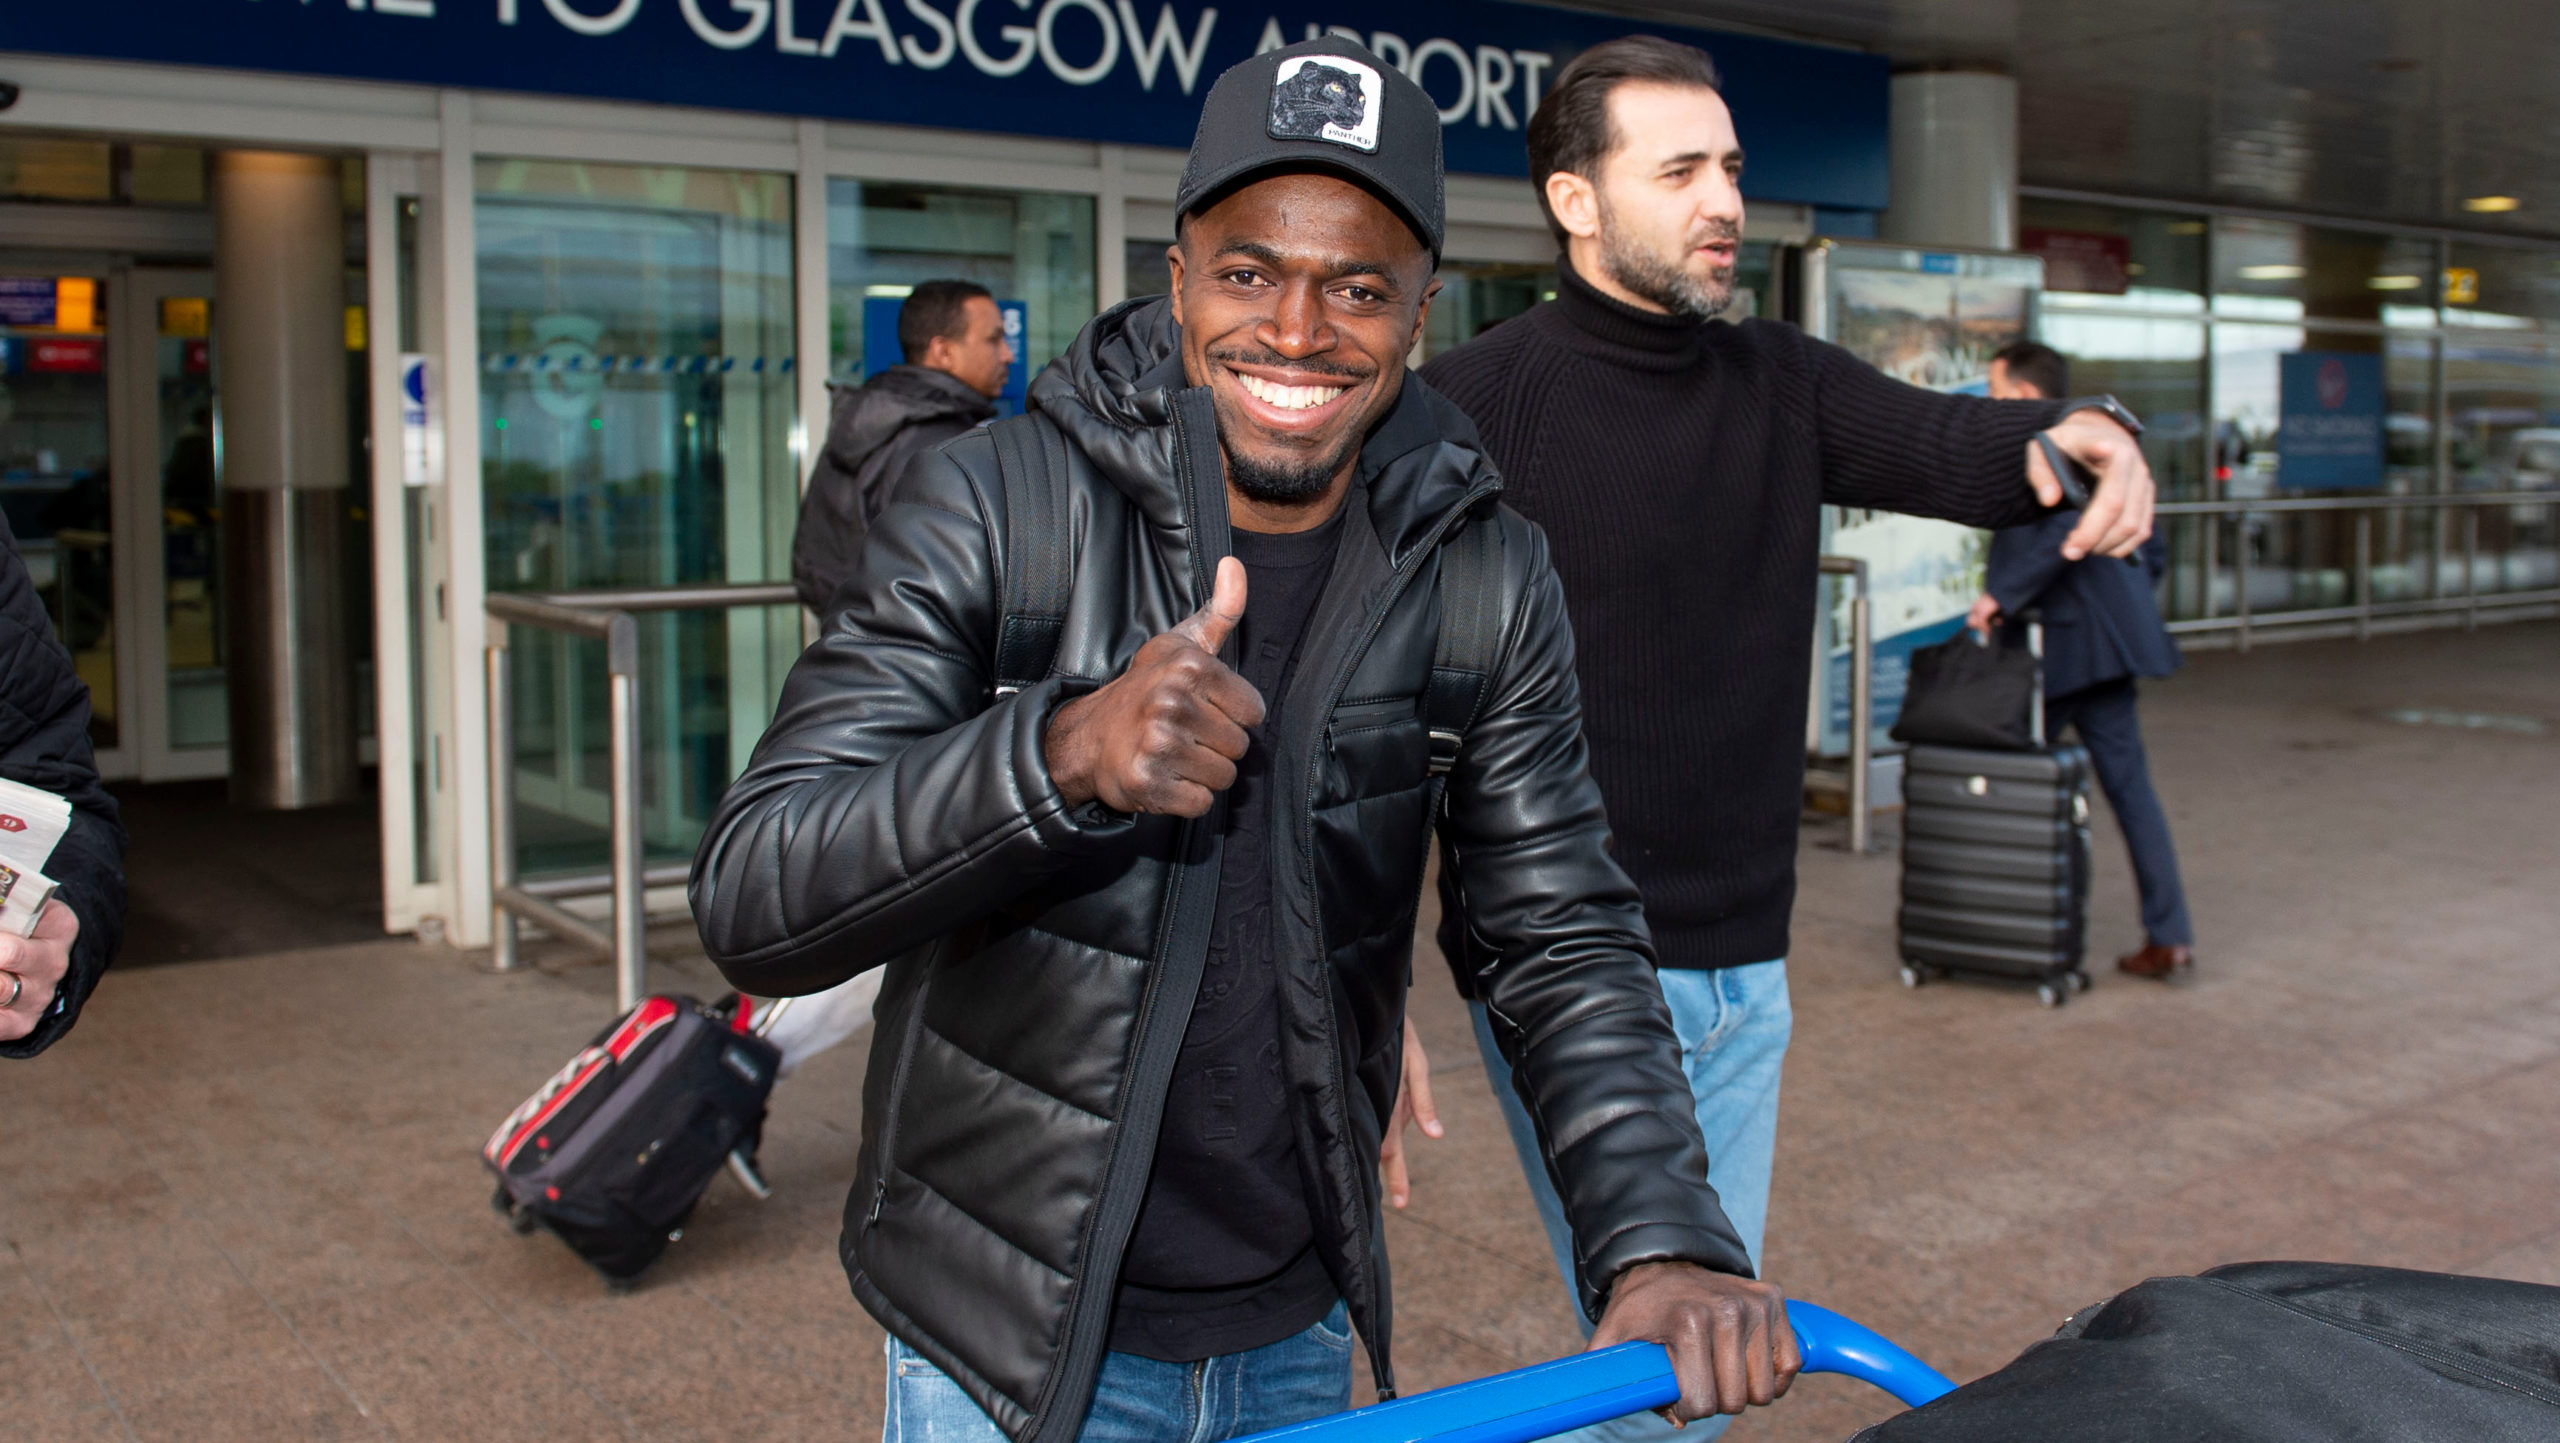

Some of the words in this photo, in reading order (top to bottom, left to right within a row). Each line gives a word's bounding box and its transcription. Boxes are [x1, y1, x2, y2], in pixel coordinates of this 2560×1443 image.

[680, 0, 1218, 95] GLASGOW
[1255, 16, 1551, 129] PORT
[1328, 129, 1372, 146] PANTHER
